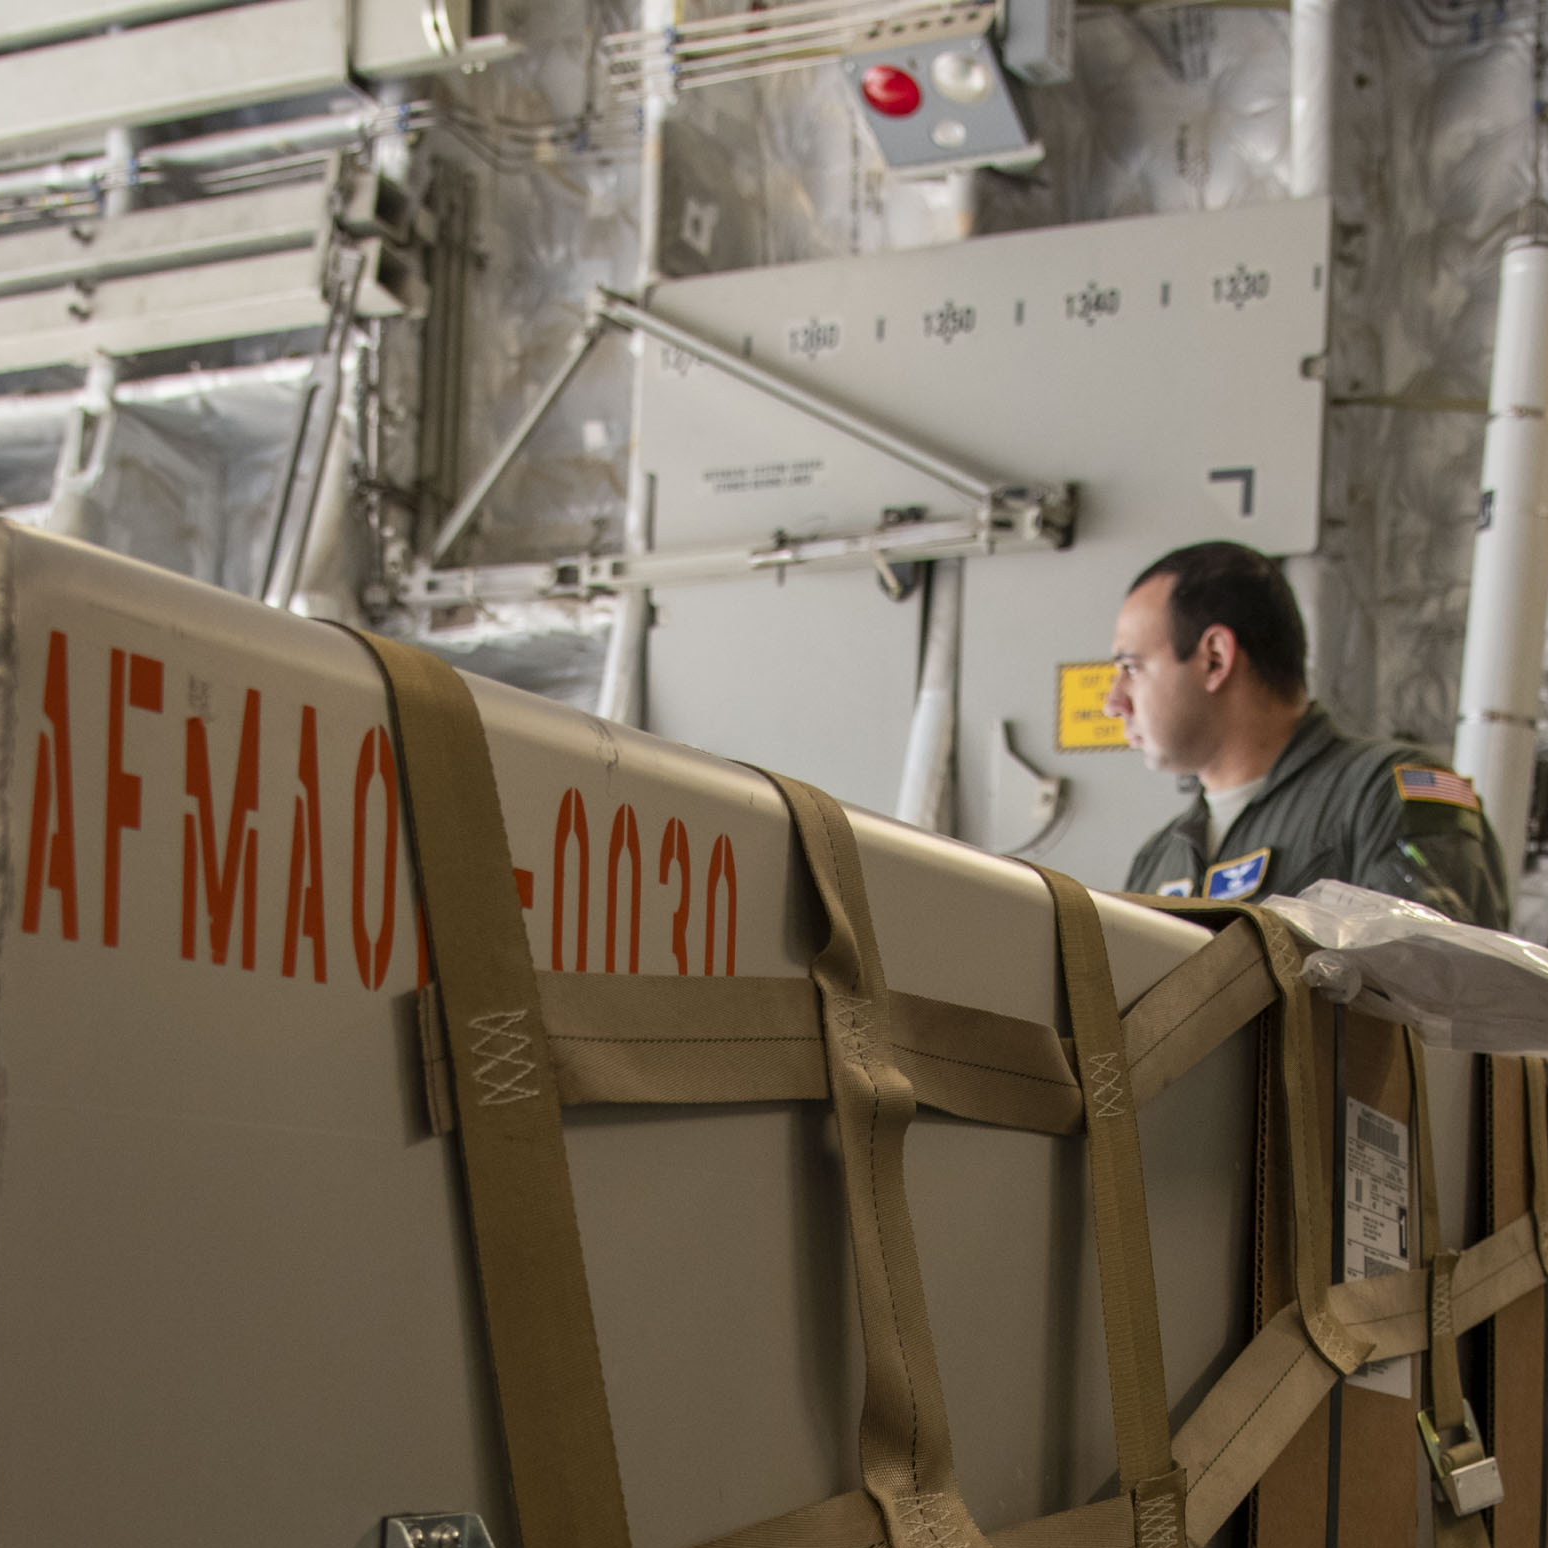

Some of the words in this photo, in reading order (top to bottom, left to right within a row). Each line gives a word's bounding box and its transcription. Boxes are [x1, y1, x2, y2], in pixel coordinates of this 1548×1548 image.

[1213, 271, 1270, 300] 1330
[1064, 289, 1120, 318] 1340
[923, 306, 976, 334] 1350
[788, 324, 840, 351] 1360
[22, 631, 736, 992] AFMA0-0030
